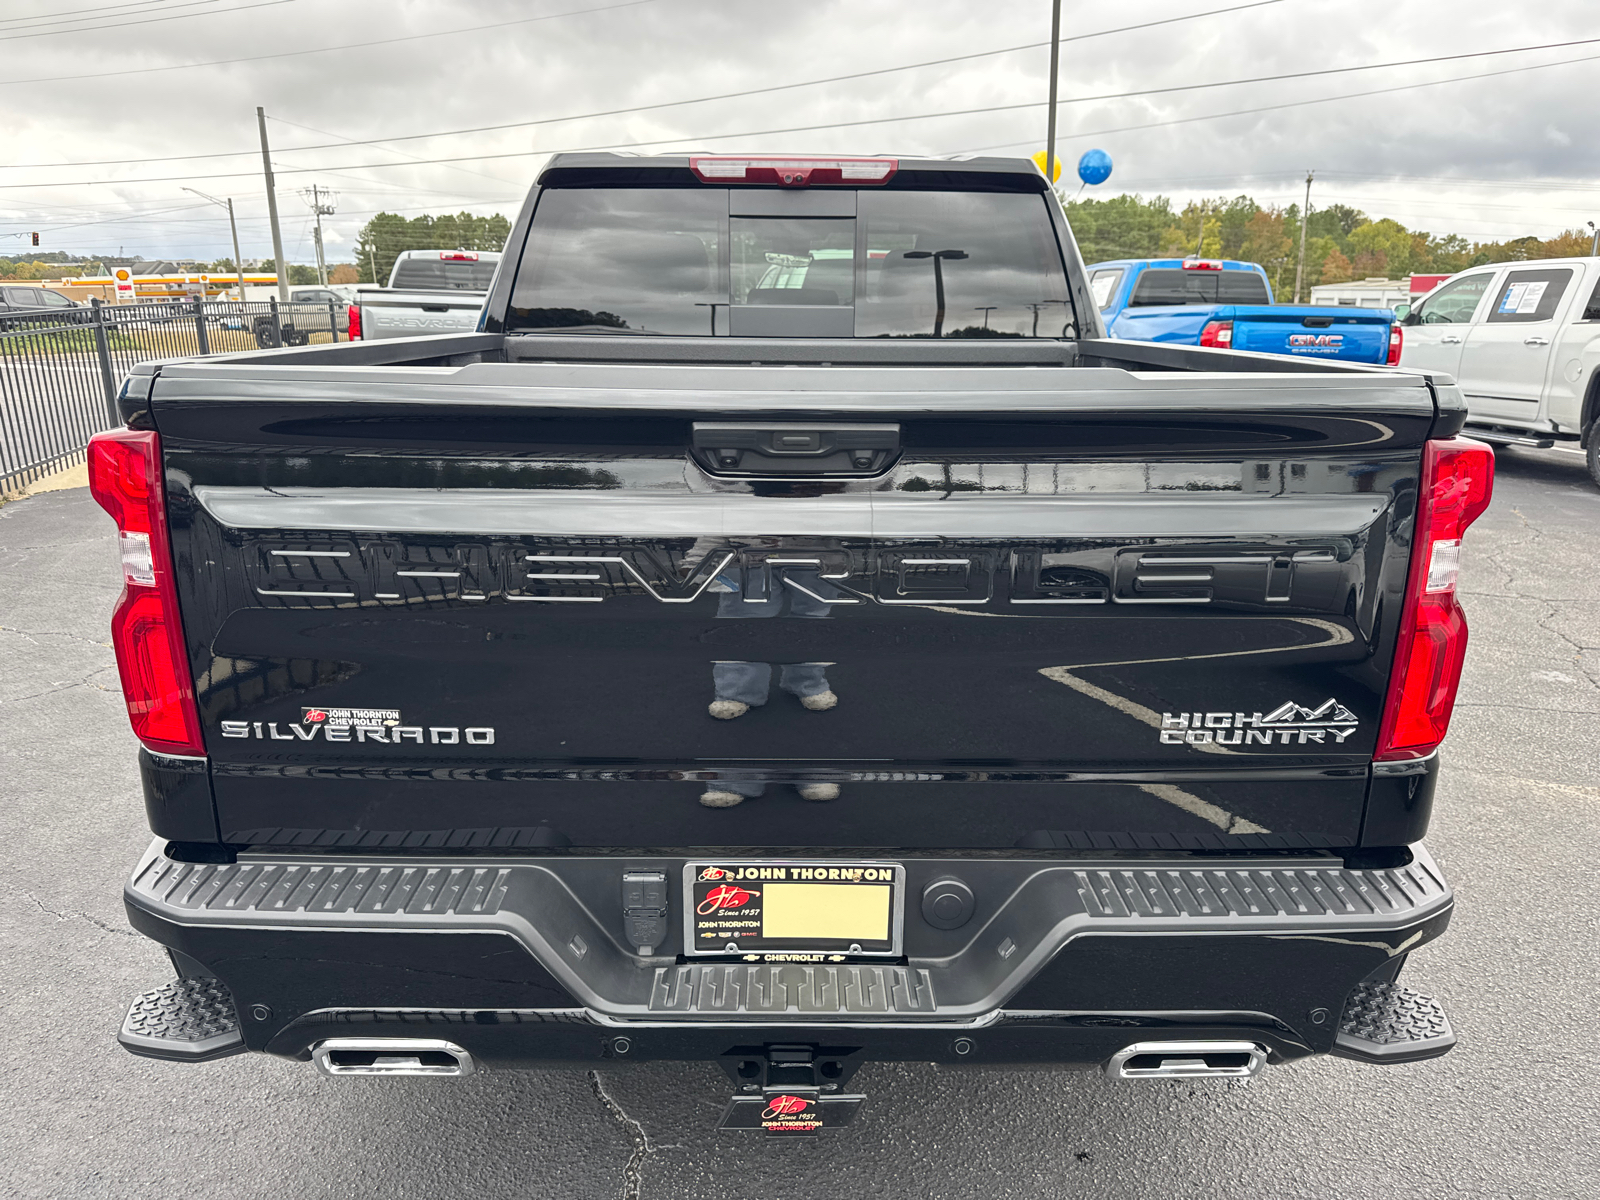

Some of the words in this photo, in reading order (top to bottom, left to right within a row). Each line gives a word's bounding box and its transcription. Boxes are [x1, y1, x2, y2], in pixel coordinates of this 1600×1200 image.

[1289, 334, 1344, 347] GMC
[254, 539, 1338, 604] CHEVROLET
[328, 709, 351, 718] JOHN
[352, 710, 400, 720] THORNTON
[1161, 712, 1264, 728] HIGH
[328, 717, 383, 726] CHEVROLET
[220, 720, 496, 745] SILVERADO
[1159, 727, 1357, 745] COUNTRY
[735, 867, 787, 880] JOHN
[790, 867, 893, 881] THORNTON
[717, 908, 740, 917] Since
[740, 908, 761, 916] 1957
[697, 921, 718, 929] JOHN
[718, 920, 761, 928] THORNTON
[764, 953, 825, 962] CHEVROLET
